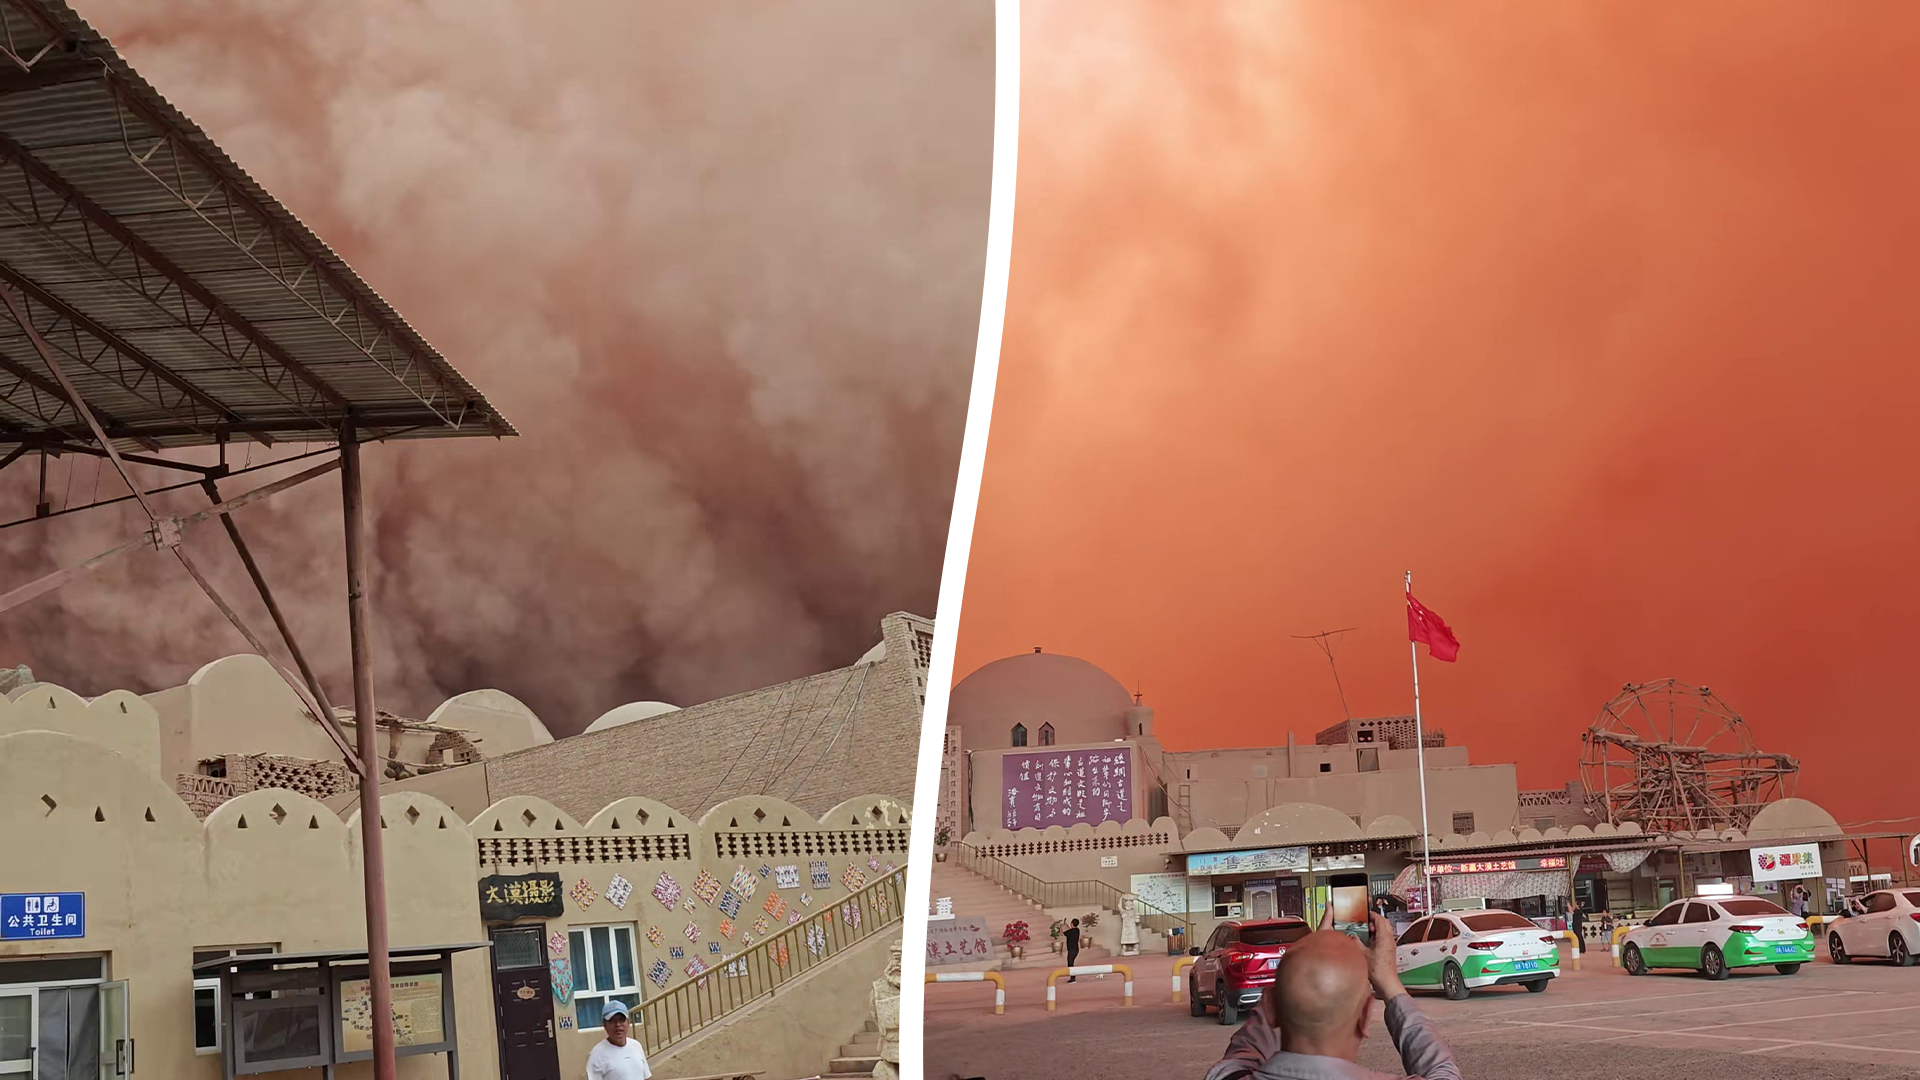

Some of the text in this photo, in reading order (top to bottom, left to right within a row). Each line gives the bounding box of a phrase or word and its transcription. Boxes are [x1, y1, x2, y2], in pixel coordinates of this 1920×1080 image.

[1223, 851, 1296, 869] 售票处
[1779, 852, 1814, 866] 疆果集
[8, 913, 77, 928] 公共卫生间
[30, 928, 55, 936] Toilet
